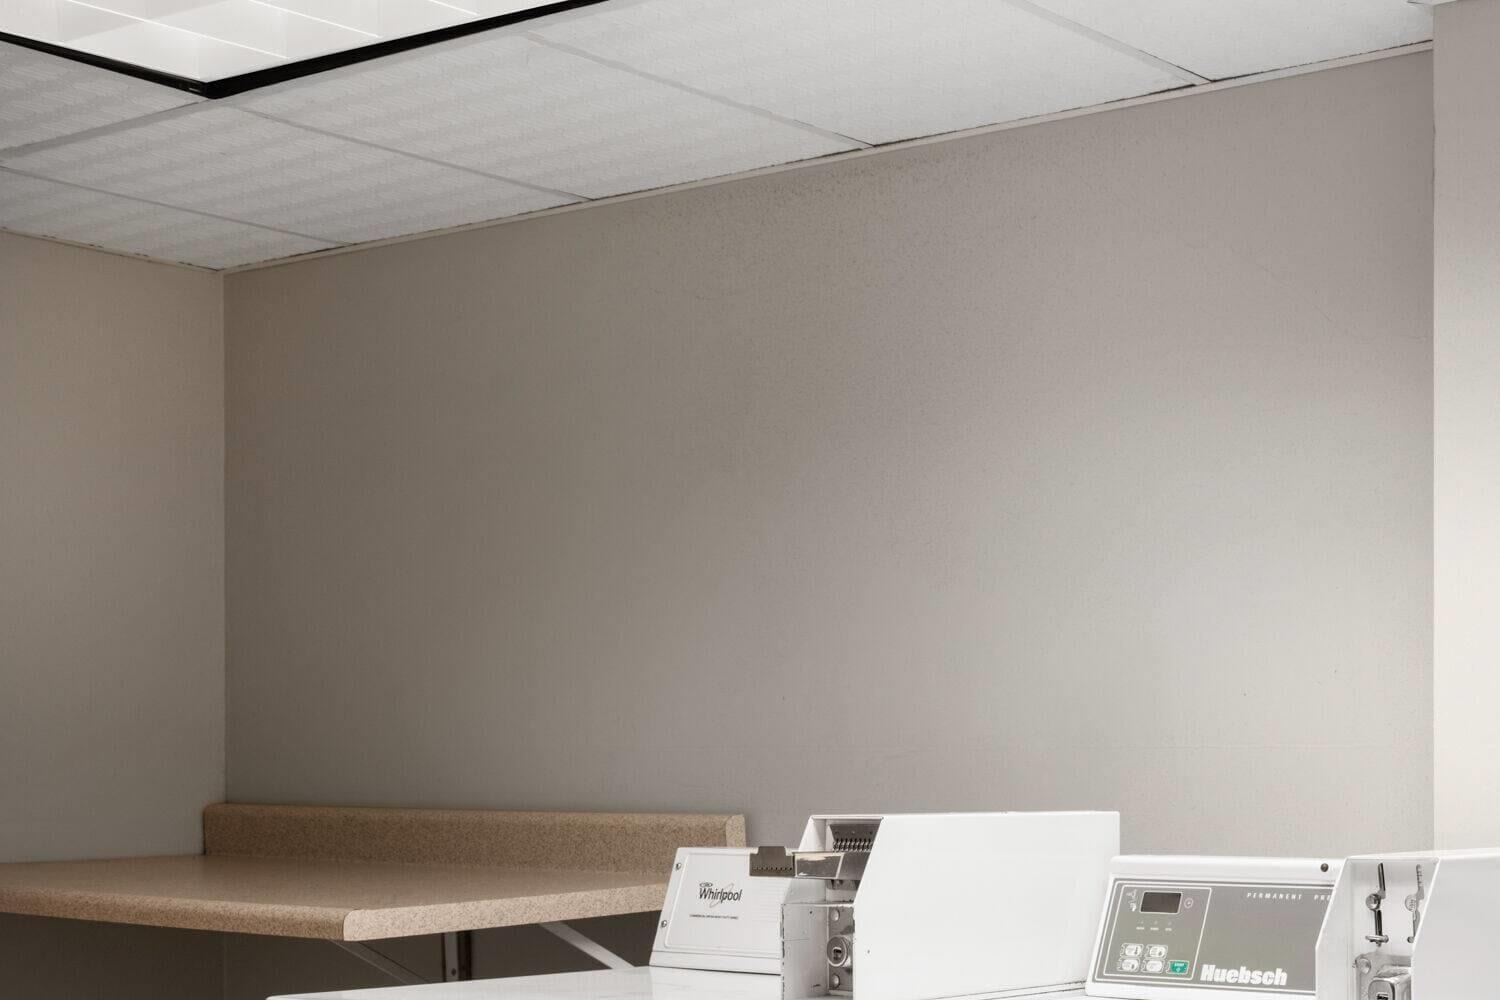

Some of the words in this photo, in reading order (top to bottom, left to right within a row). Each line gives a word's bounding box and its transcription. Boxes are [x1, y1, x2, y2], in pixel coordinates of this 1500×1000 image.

[699, 887, 743, 904] Whirlpool
[1246, 892, 1302, 900] PERMANENT
[1200, 964, 1288, 986] Huebsch
